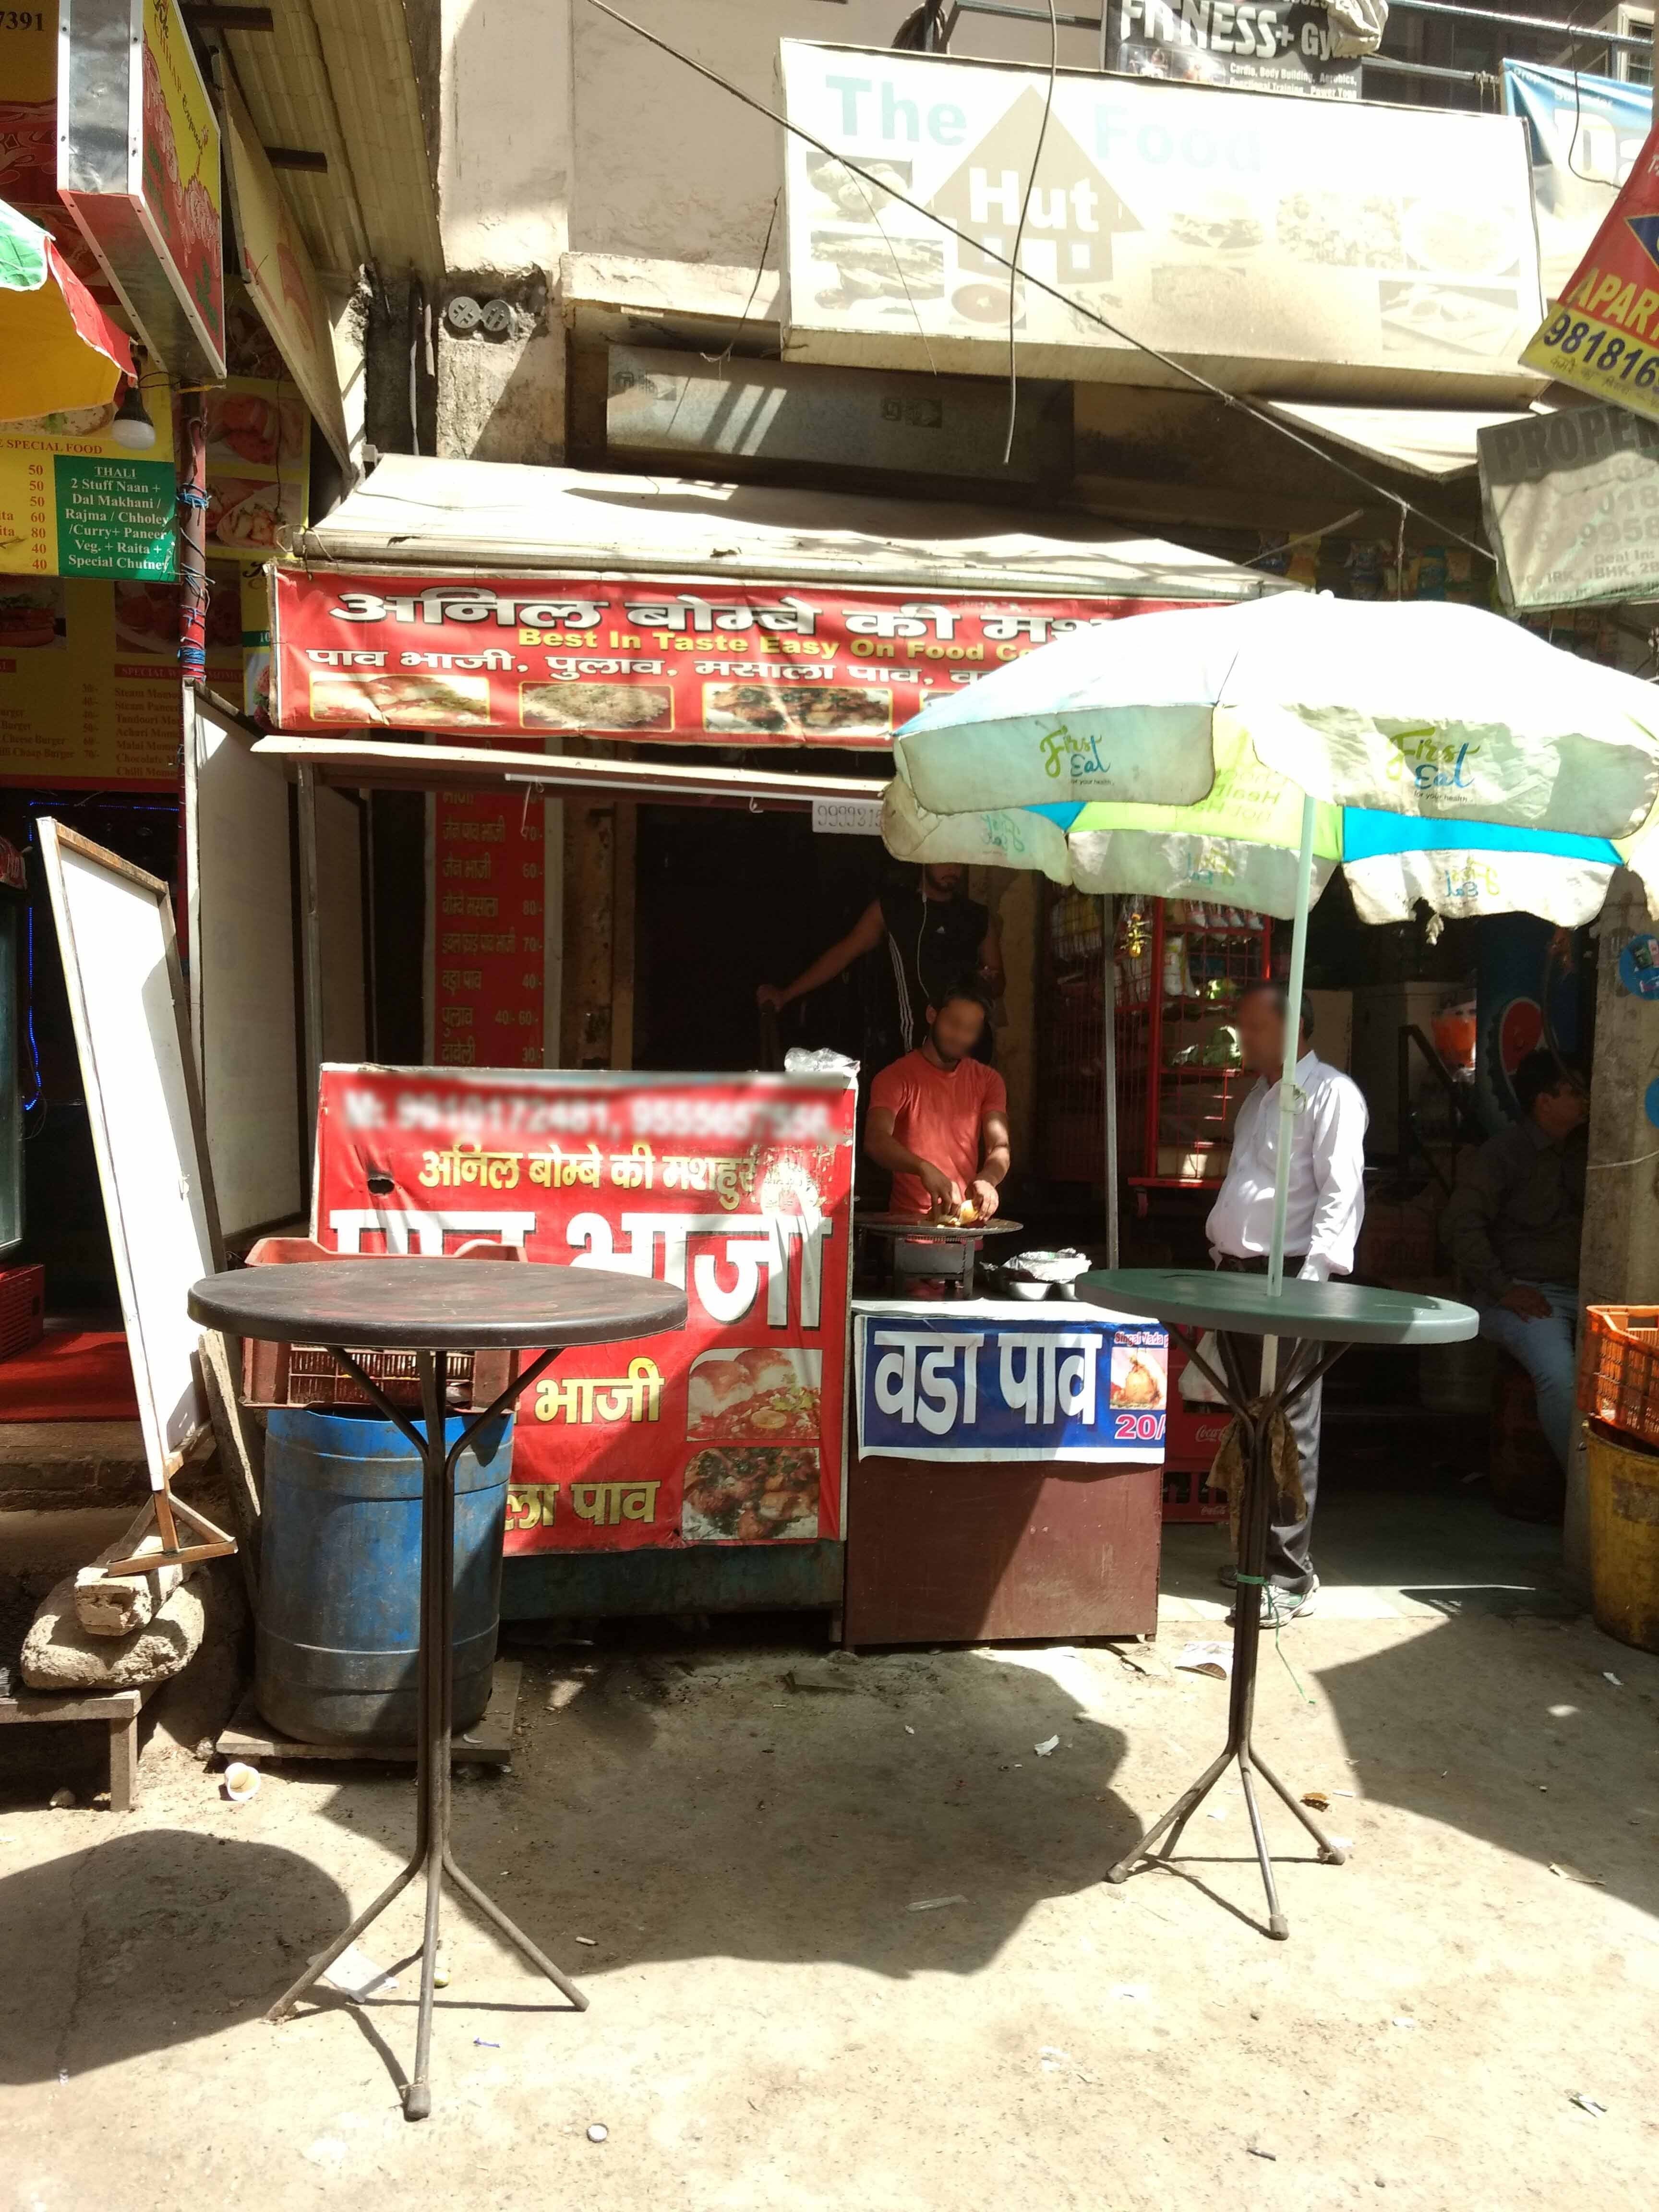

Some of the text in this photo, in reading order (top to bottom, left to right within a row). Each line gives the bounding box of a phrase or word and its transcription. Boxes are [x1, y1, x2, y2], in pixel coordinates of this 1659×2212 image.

[825, 74, 1262, 173] The Food
[969, 166, 1099, 233] Hut
[1566, 267, 1659, 342] APAR
[7, 439, 62, 452] SPECIAL
[66, 444, 103, 454] FOOD
[28, 464, 43, 476] 50
[95, 466, 136, 478] THALI
[29, 480, 44, 491] 50
[71, 478, 78, 489] 2
[82, 479, 114, 491] Stuff
[117, 481, 149, 493] Naan
[30, 496, 45, 507] 50
[72, 493, 94, 505] Dal
[98, 494, 154, 508] Makhani
[31, 512, 45, 523] 60
[65, 508, 107, 522] Rajma
[118, 512, 170, 527] Chholey
[31, 528, 46, 539] 80
[124, 527, 167, 540] Paneer
[32, 543, 46, 554] 40
[75, 540, 101, 554] Veg.
[117, 542, 150, 554] Raita
[33, 559, 47, 569] 40
[69, 554, 170, 573] Special Chutney
[329, 585, 609, 628] अनिल
[624, 593, 822, 635] बोम्बे
[842, 602, 962, 641] की
[518, 628, 598, 648] Best
[610, 632, 641, 649] In
[653, 632, 749, 652] Taste
[760, 636, 840, 660] Easy
[851, 639, 895, 659] On
[907, 641, 985, 661] Food
[305, 649, 388, 667] पाव
[694, 660, 837, 680] मसाला
[610, 1141, 656, 1190] की
[1142, 1331, 1164, 1345] Vada
[534, 1357, 665, 1424] भाजी
[874, 1331, 1103, 1435] वडा पाव
[571, 1481, 661, 1525] पाव
